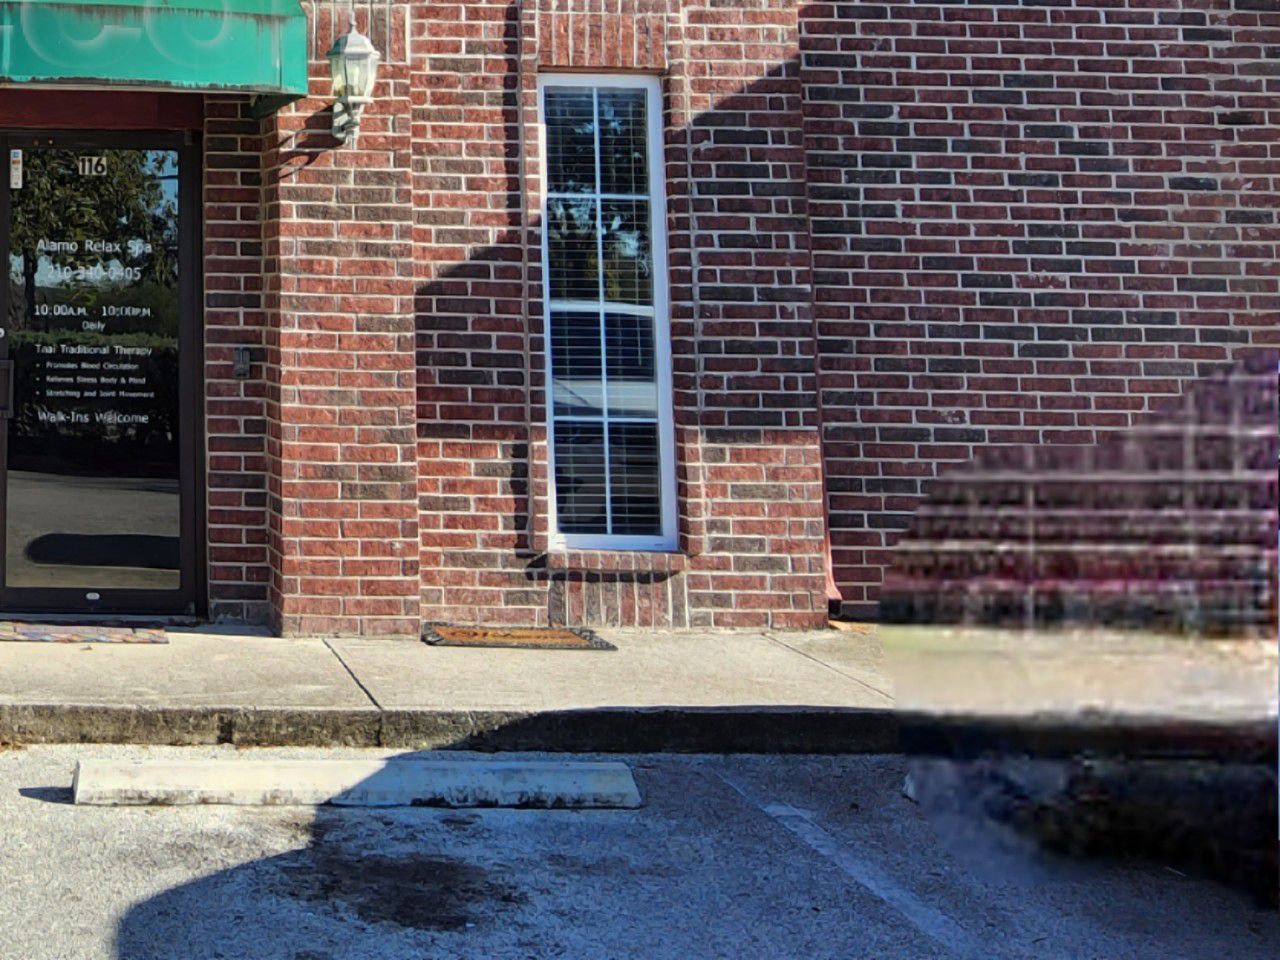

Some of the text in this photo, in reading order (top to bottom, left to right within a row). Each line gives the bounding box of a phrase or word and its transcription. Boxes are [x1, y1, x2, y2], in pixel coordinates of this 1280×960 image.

[80, 157, 107, 174] 116
[36, 239, 152, 257] Alamo Relax Spa
[81, 320, 106, 331] Daily
[60, 344, 110, 355] Traditional
[113, 345, 152, 357] Therapy
[83, 390, 97, 398] and
[37, 410, 150, 425] Walk-Ins Welcome
